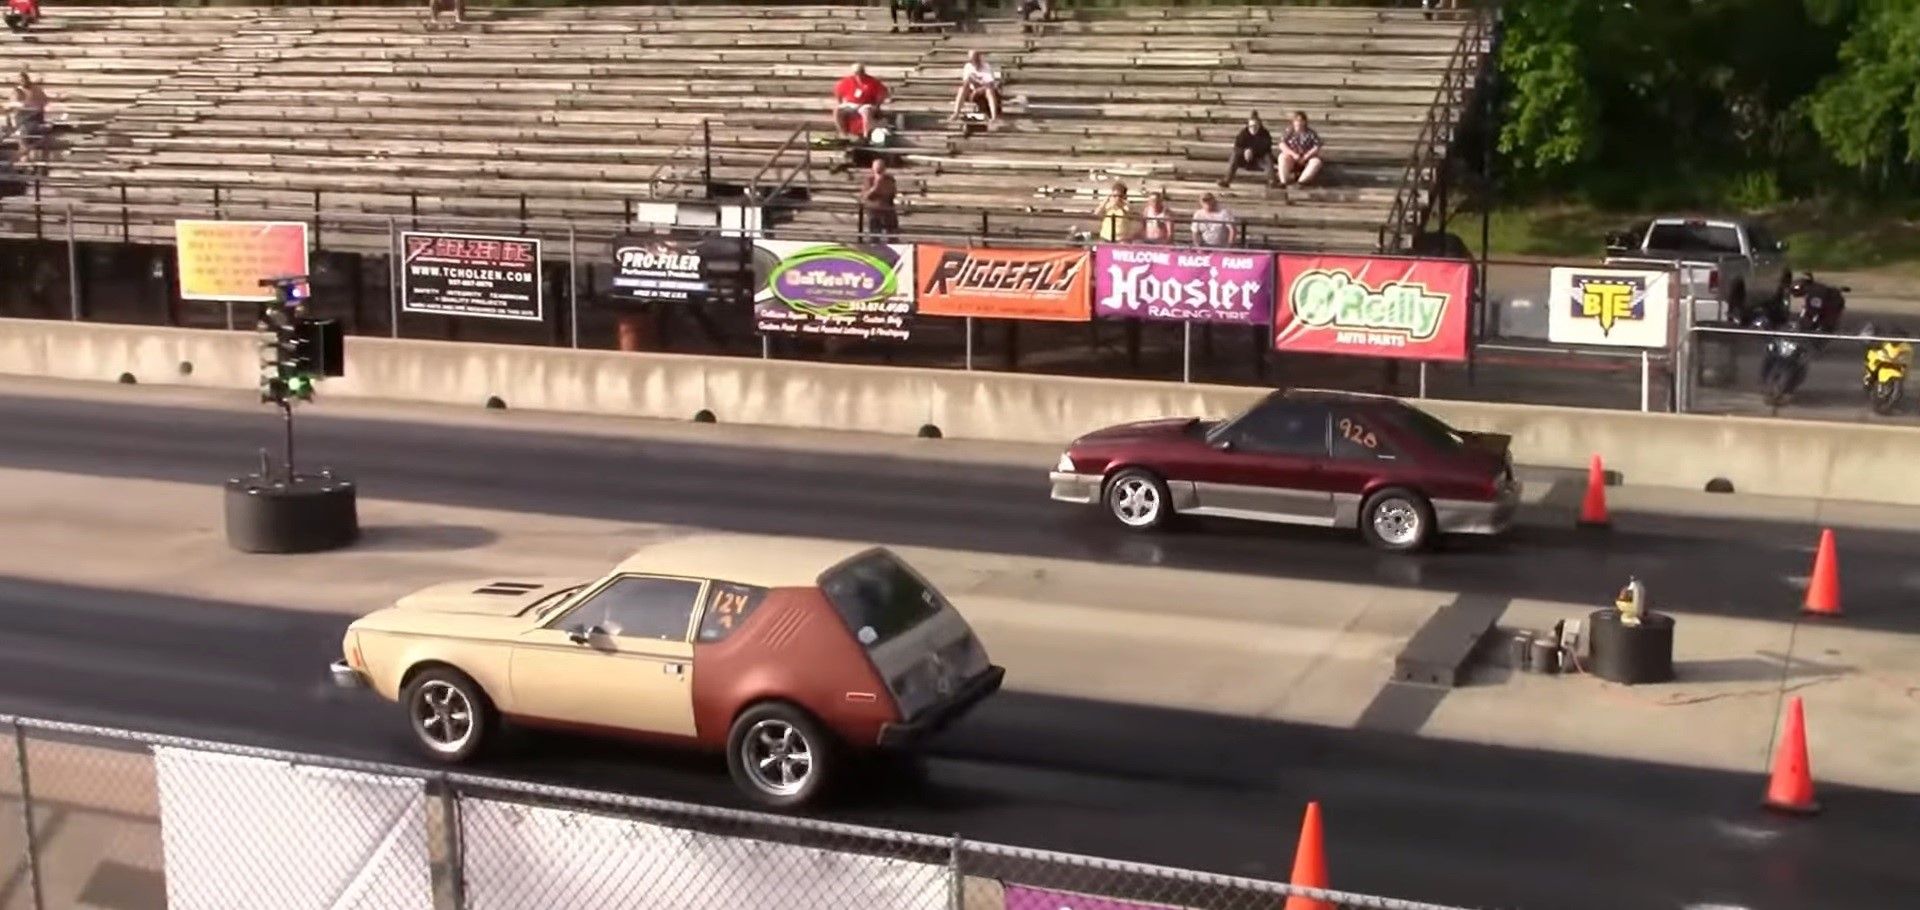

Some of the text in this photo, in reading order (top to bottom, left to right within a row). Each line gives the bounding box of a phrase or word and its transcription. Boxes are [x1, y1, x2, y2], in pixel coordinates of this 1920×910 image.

[621, 251, 701, 271] PRO-FILER
[1112, 250, 1254, 270] WELCOME RACE FANS
[410, 265, 532, 282] WWW.TCHOLZEN.COM
[1101, 264, 1261, 310] Hoosier
[1147, 304, 1212, 319] RACING
[1583, 282, 1634, 330] BTE
[1336, 330, 1406, 348] AUTO PARTS
[711, 590, 749, 614] 124
